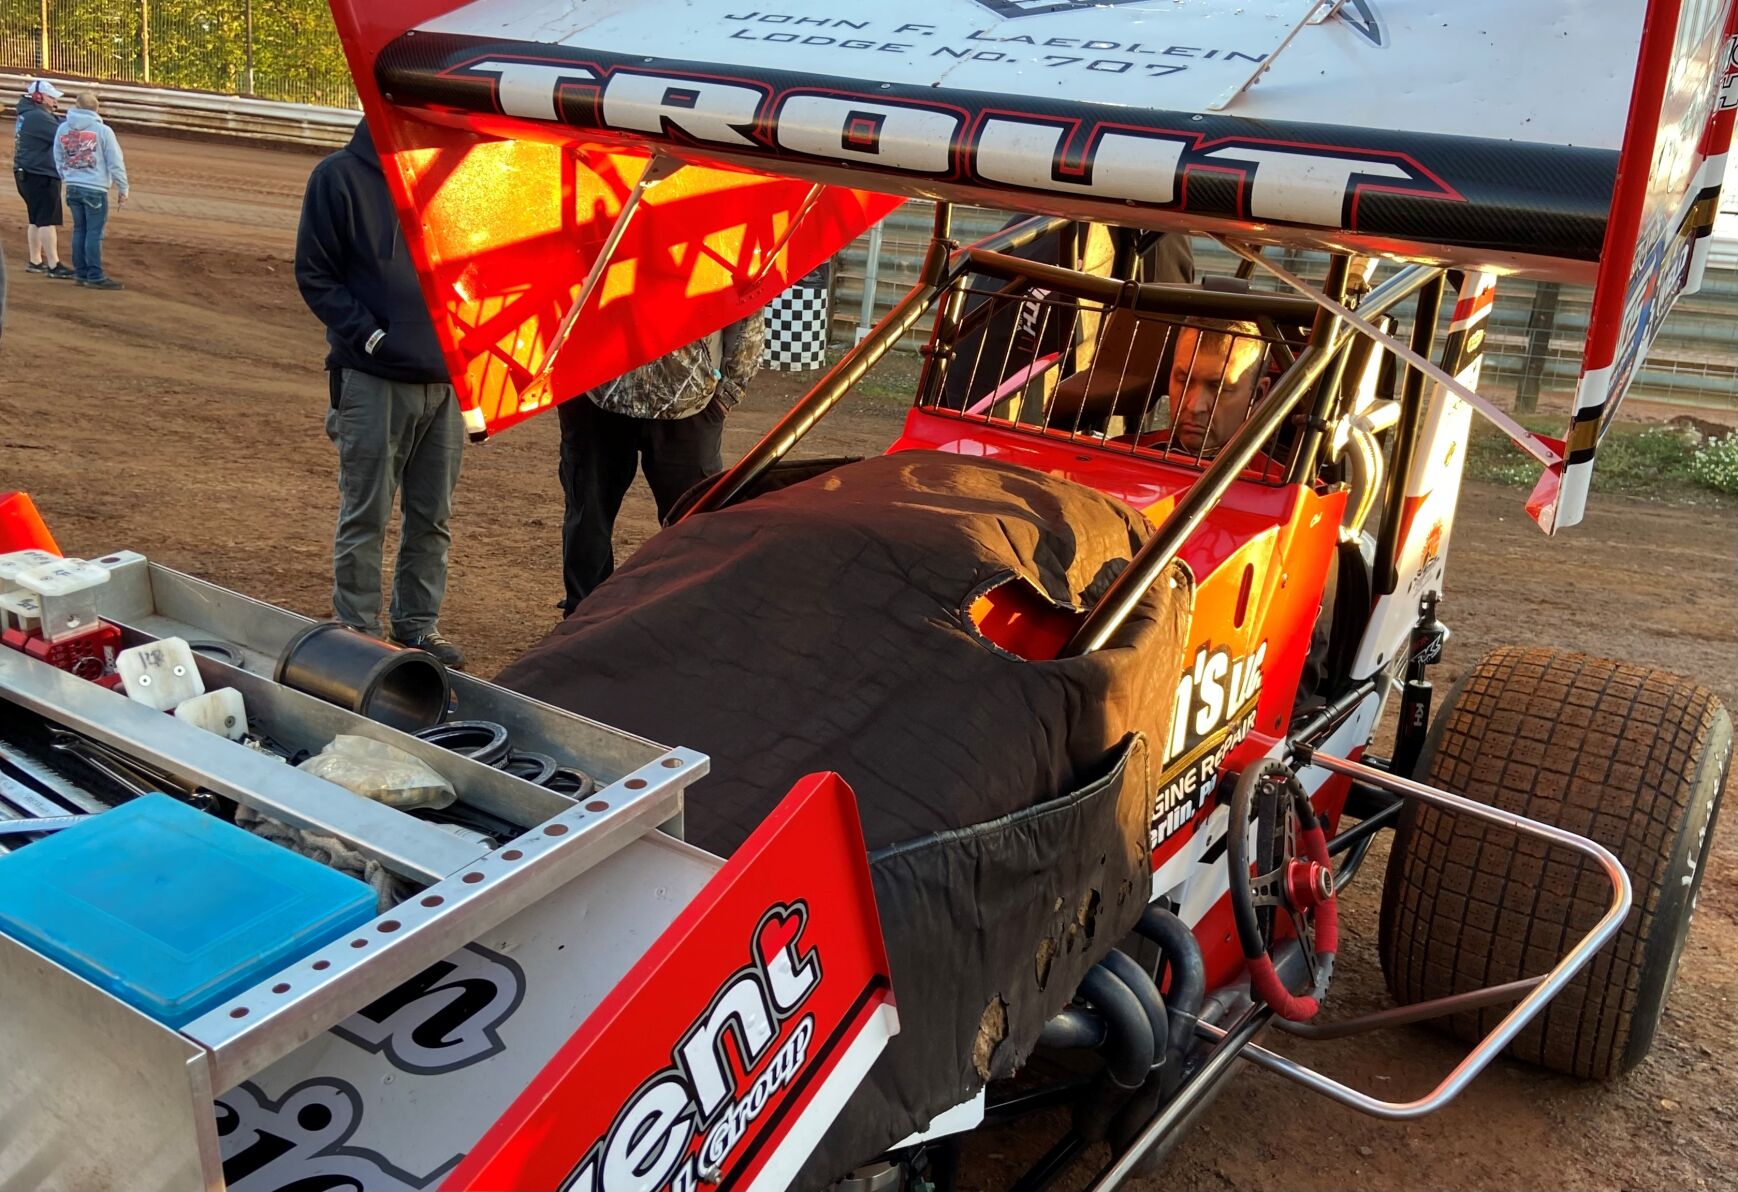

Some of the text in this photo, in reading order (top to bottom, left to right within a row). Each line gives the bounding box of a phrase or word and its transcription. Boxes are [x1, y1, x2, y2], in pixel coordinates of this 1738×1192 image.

[724, 11, 1269, 64] JOHN F. LAEDLEIN
[729, 28, 1190, 77] LODGE NO. 707
[468, 58, 1414, 228] TROUT
[1201, 709, 1257, 782] REPAIR
[555, 897, 823, 1192] ent
[698, 1010, 816, 1176] Group
